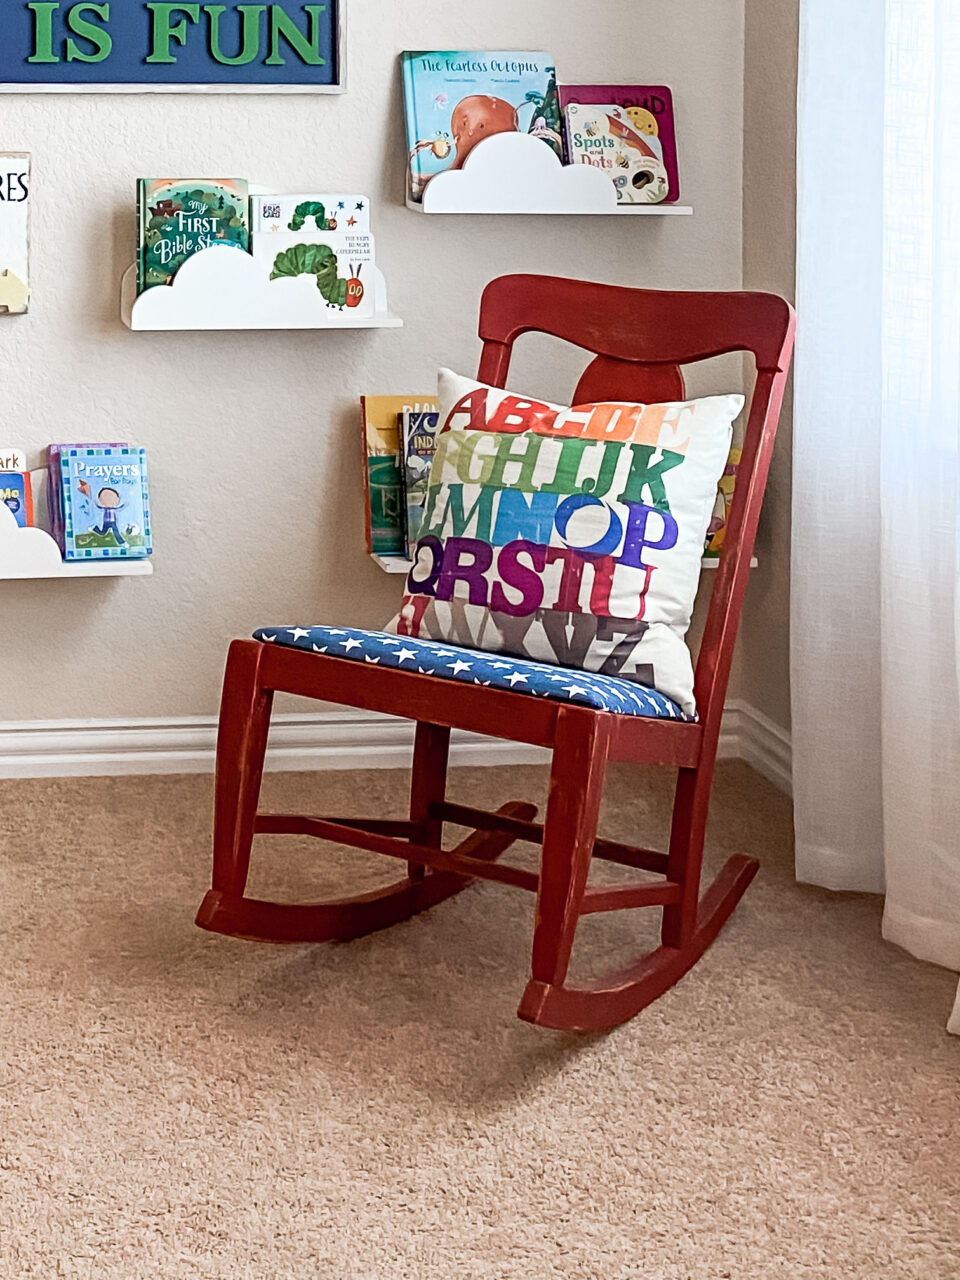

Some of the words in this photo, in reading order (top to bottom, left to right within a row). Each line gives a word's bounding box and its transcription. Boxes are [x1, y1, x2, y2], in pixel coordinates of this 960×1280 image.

[27, 2, 113, 63] IS
[145, 1, 326, 65] FUN
[422, 59, 443, 72] The
[445, 59, 488, 73] Fearless
[490, 60, 539, 76] Octopus
[573, 133, 615, 152] Spots
[590, 148, 604, 156] and
[580, 154, 613, 168] Dots
[174, 210, 220, 234] FIRST
[153, 234, 193, 264] Bible
[73, 462, 140, 482] Prayers
